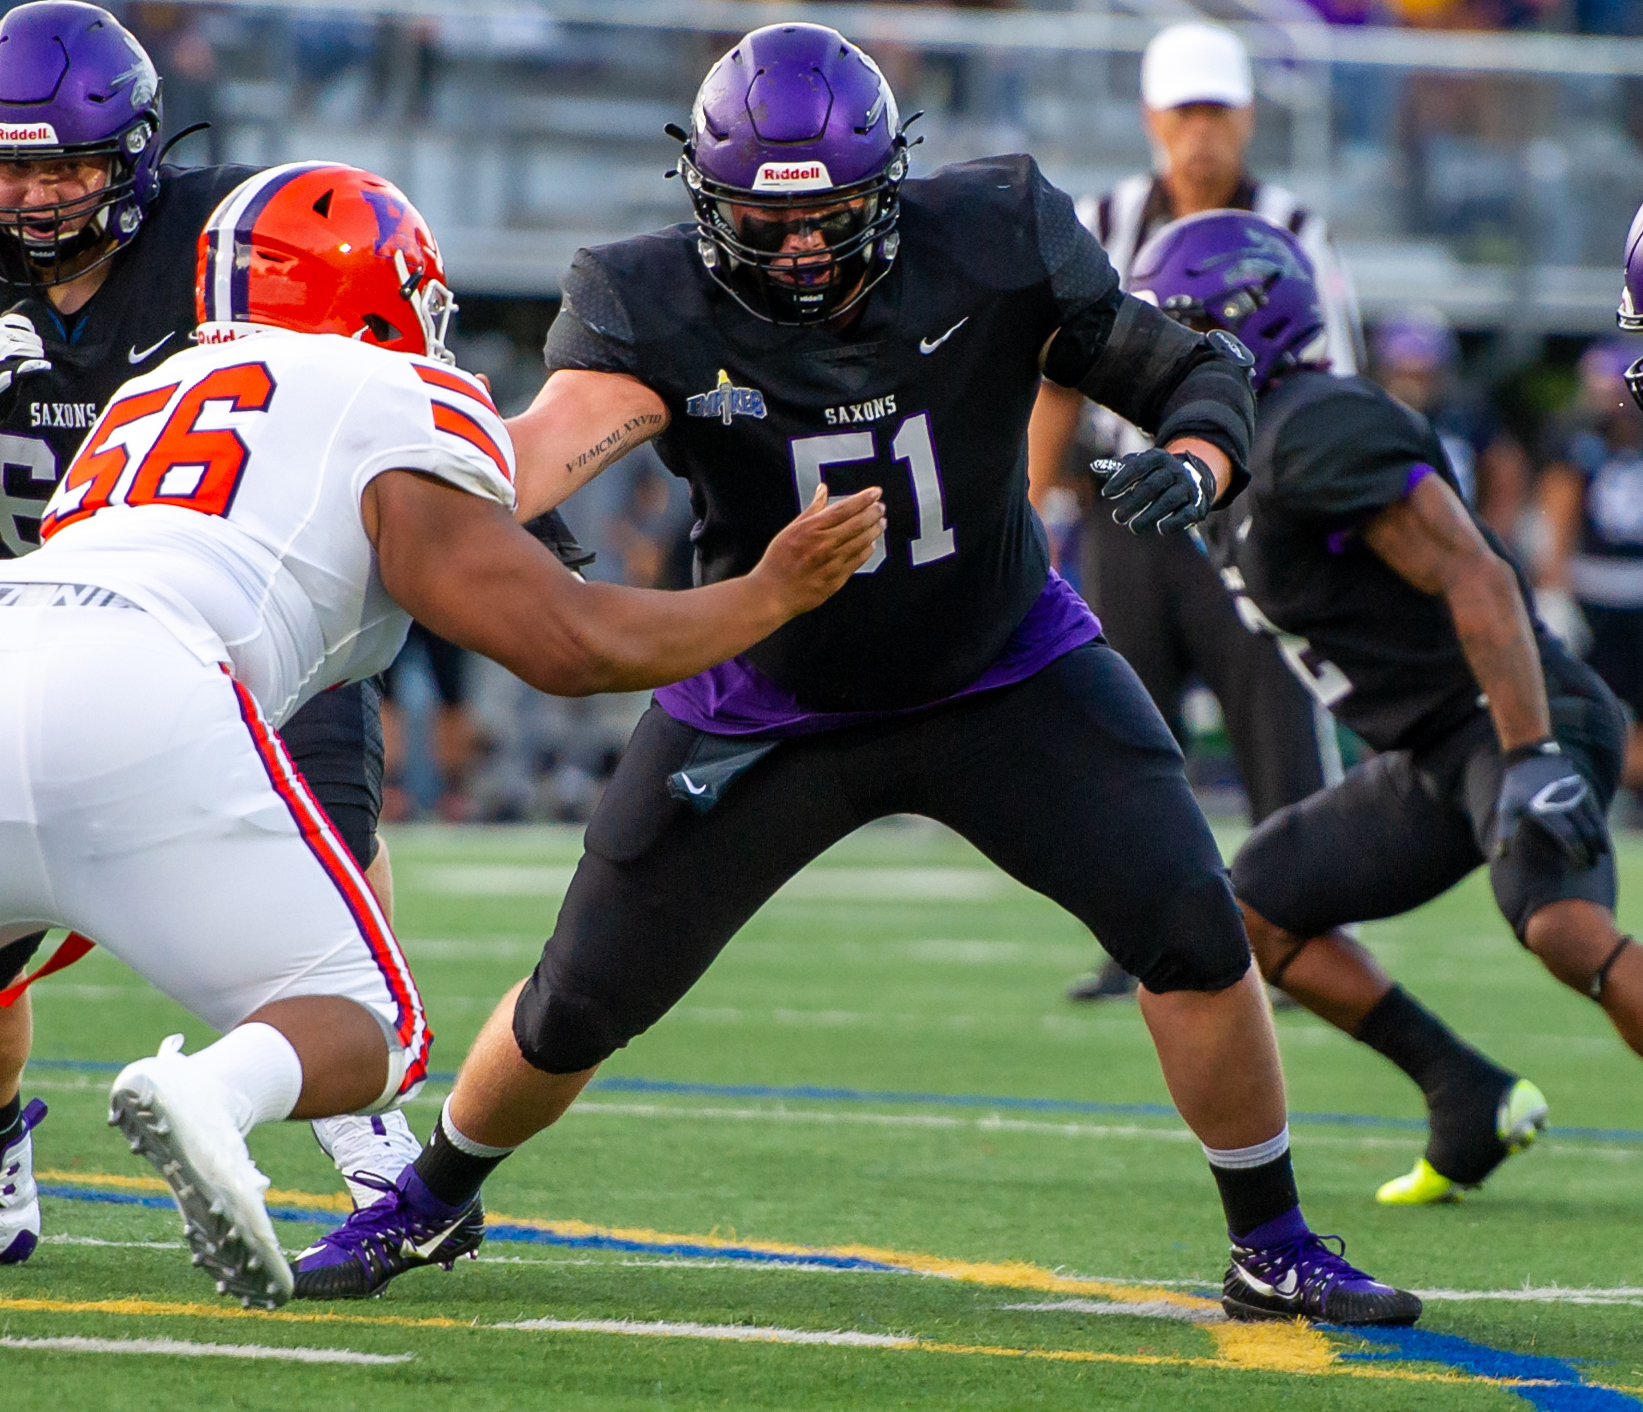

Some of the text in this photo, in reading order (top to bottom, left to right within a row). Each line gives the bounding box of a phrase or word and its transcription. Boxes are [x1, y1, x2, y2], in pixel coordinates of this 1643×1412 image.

[764, 167, 820, 180] Riddell
[30, 402, 97, 428] SAXONS
[824, 394, 898, 425] SAXONS
[40, 361, 277, 543] 56
[787, 409, 958, 577] 51
